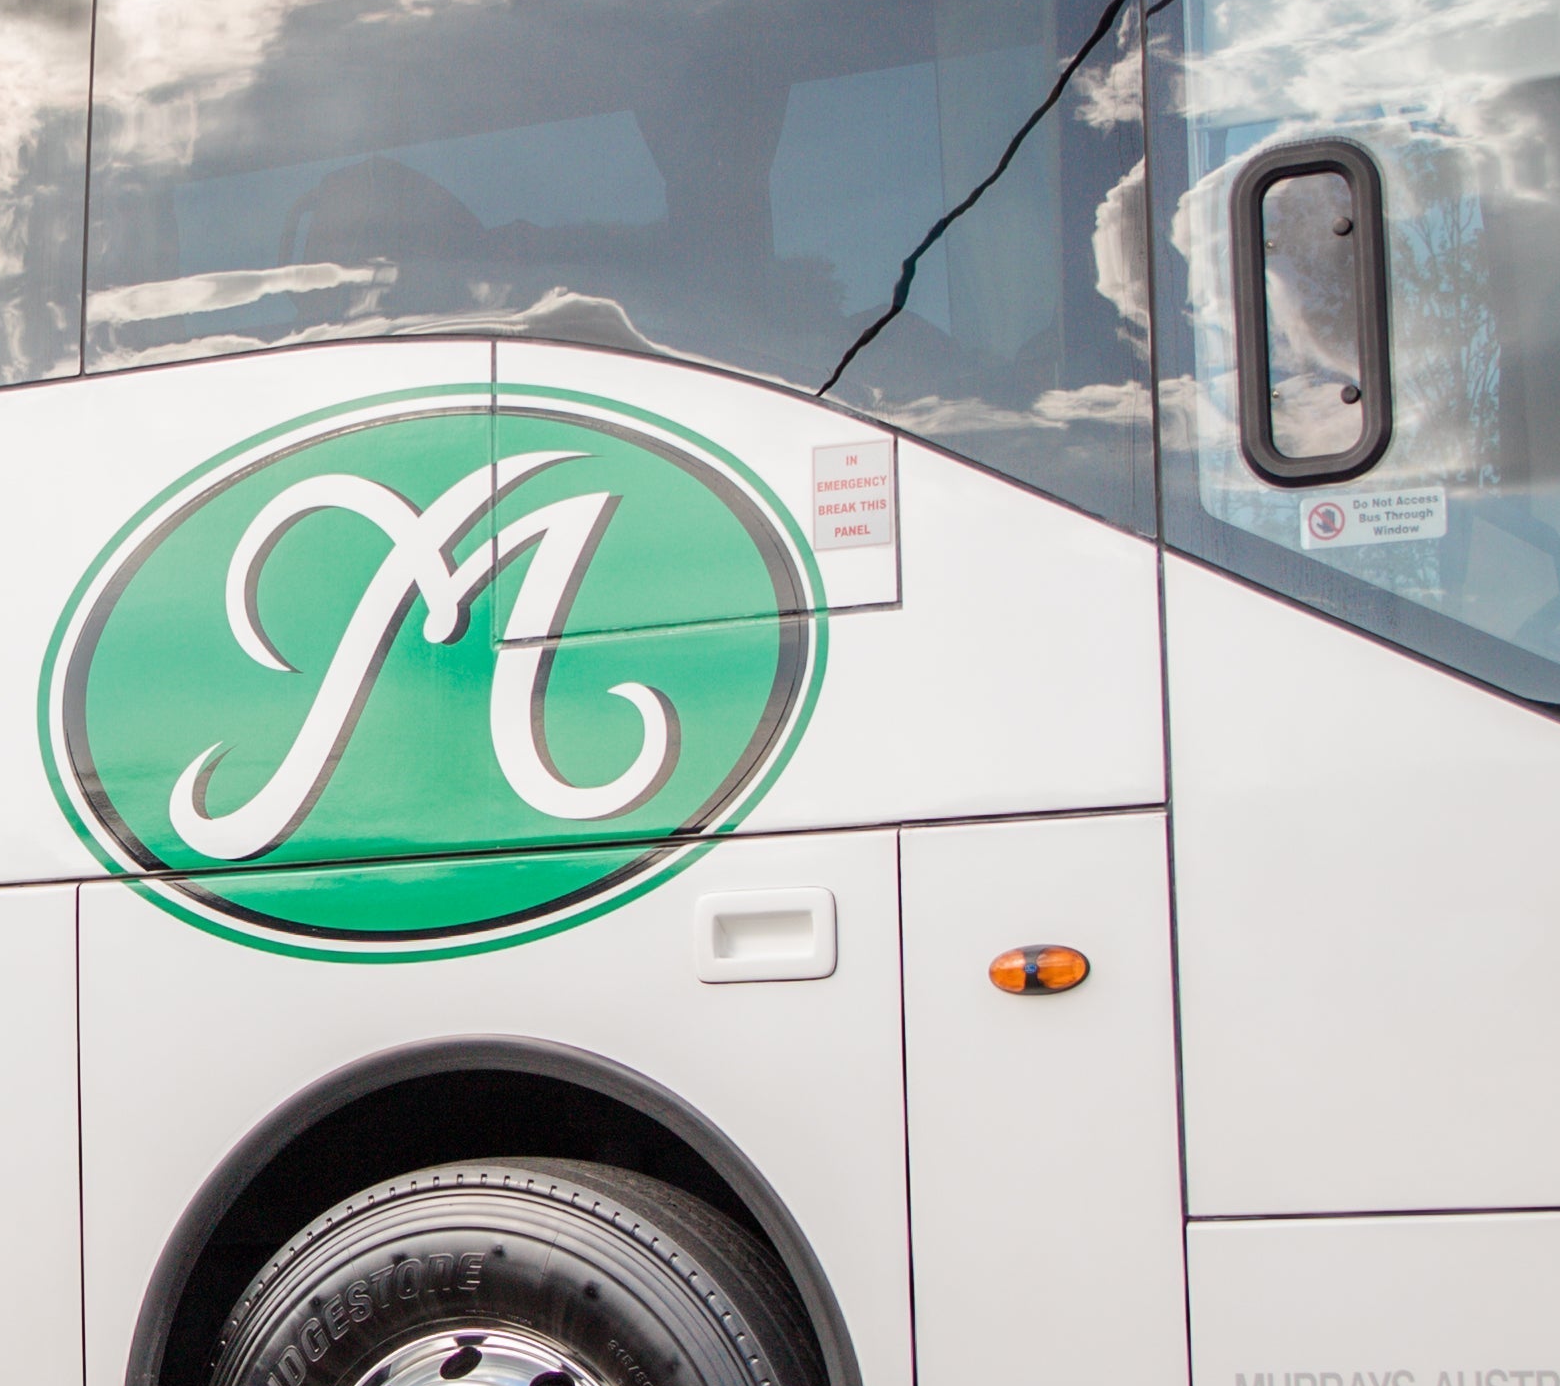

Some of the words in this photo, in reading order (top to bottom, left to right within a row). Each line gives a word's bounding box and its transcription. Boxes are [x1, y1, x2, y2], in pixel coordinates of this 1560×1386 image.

[845, 455, 858, 466] IN
[816, 475, 887, 493] EMERGENCY
[818, 501, 857, 516] BREAK
[860, 498, 887, 512] THIS
[1352, 499, 1368, 510] Do
[1372, 496, 1392, 508] Not
[1396, 493, 1439, 506] Access
[1358, 513, 1380, 524] Bus
[1383, 508, 1433, 523] Through
[834, 524, 871, 538] PANEL
[1372, 524, 1420, 537] Window
